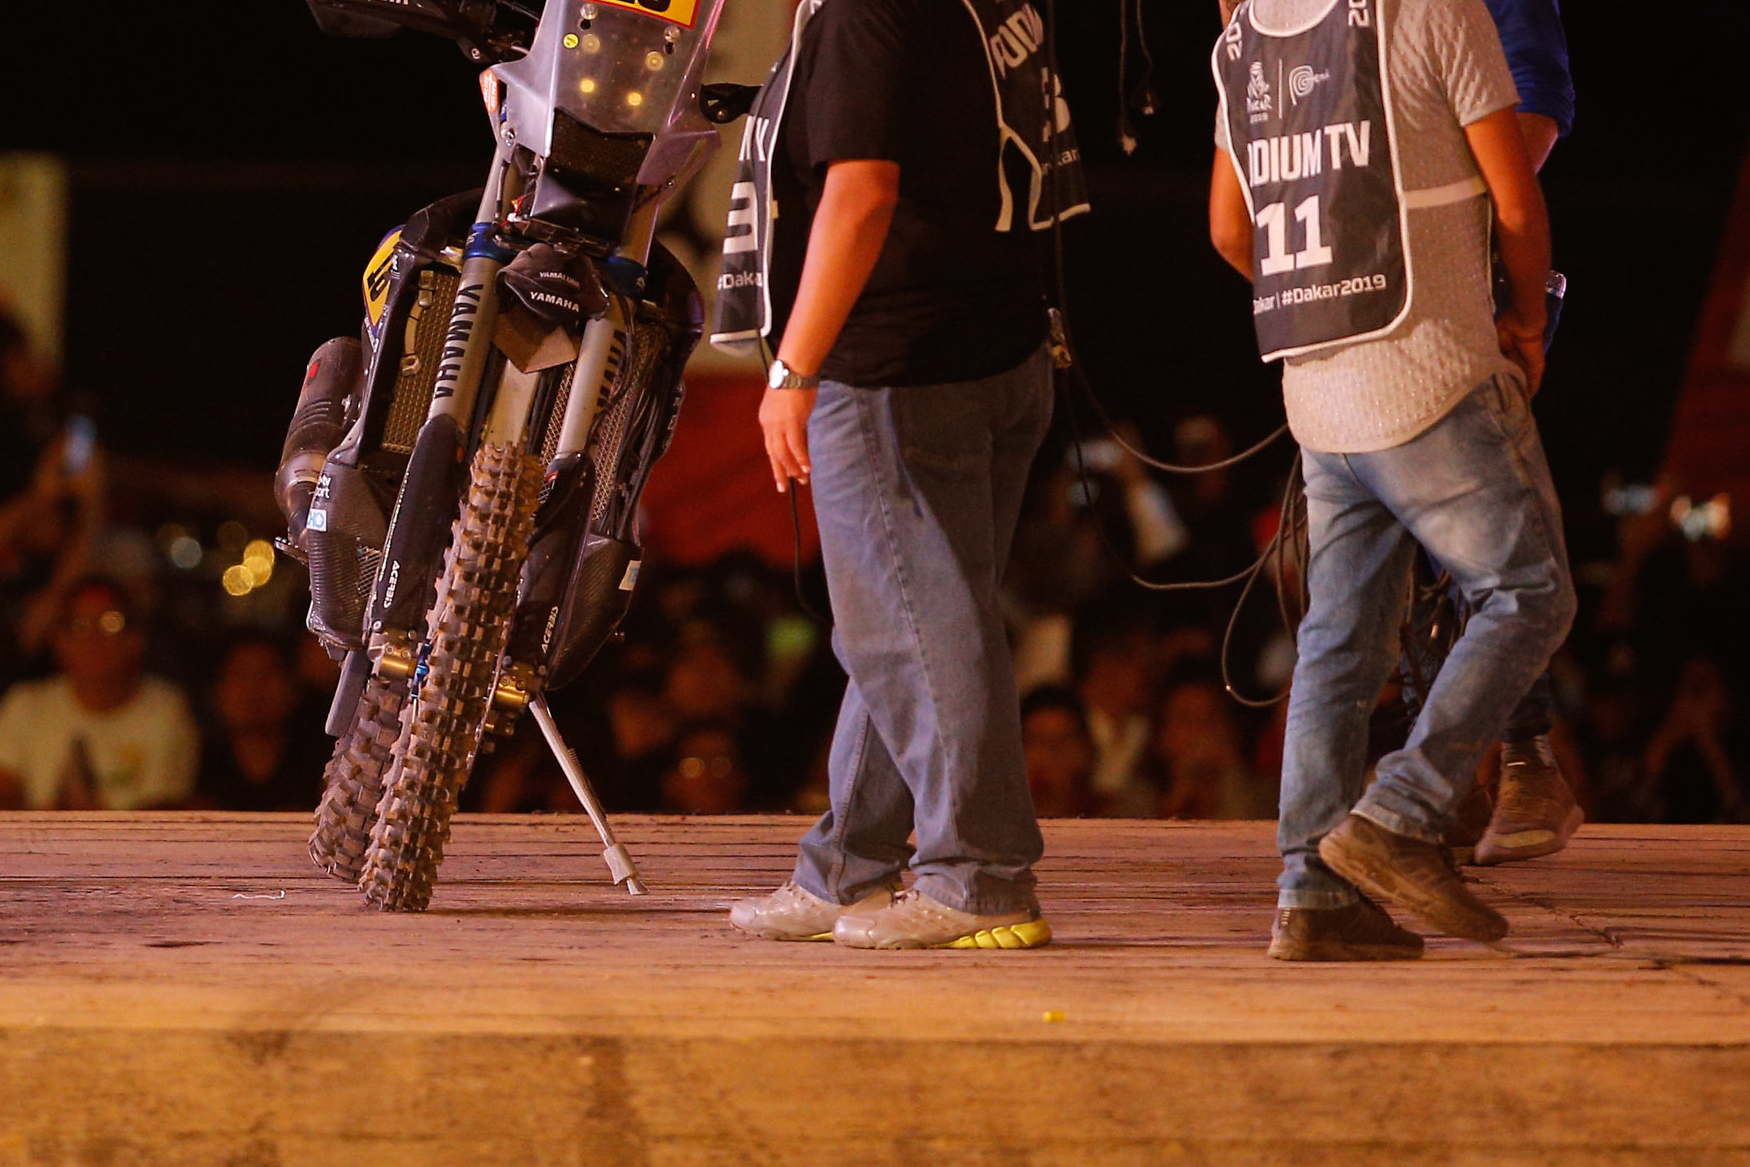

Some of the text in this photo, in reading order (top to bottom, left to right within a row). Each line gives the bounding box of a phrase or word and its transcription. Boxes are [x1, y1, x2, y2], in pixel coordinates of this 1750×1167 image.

[1247, 120, 1371, 188] DIUM TV
[1255, 195, 1333, 276] 11
[529, 291, 580, 313] YAMAHA
[1281, 274, 1386, 306] #Dakar2019
[433, 282, 484, 399] YAMAHA
[383, 560, 401, 610] ACERBIS
[540, 605, 560, 654] ACERBIS
